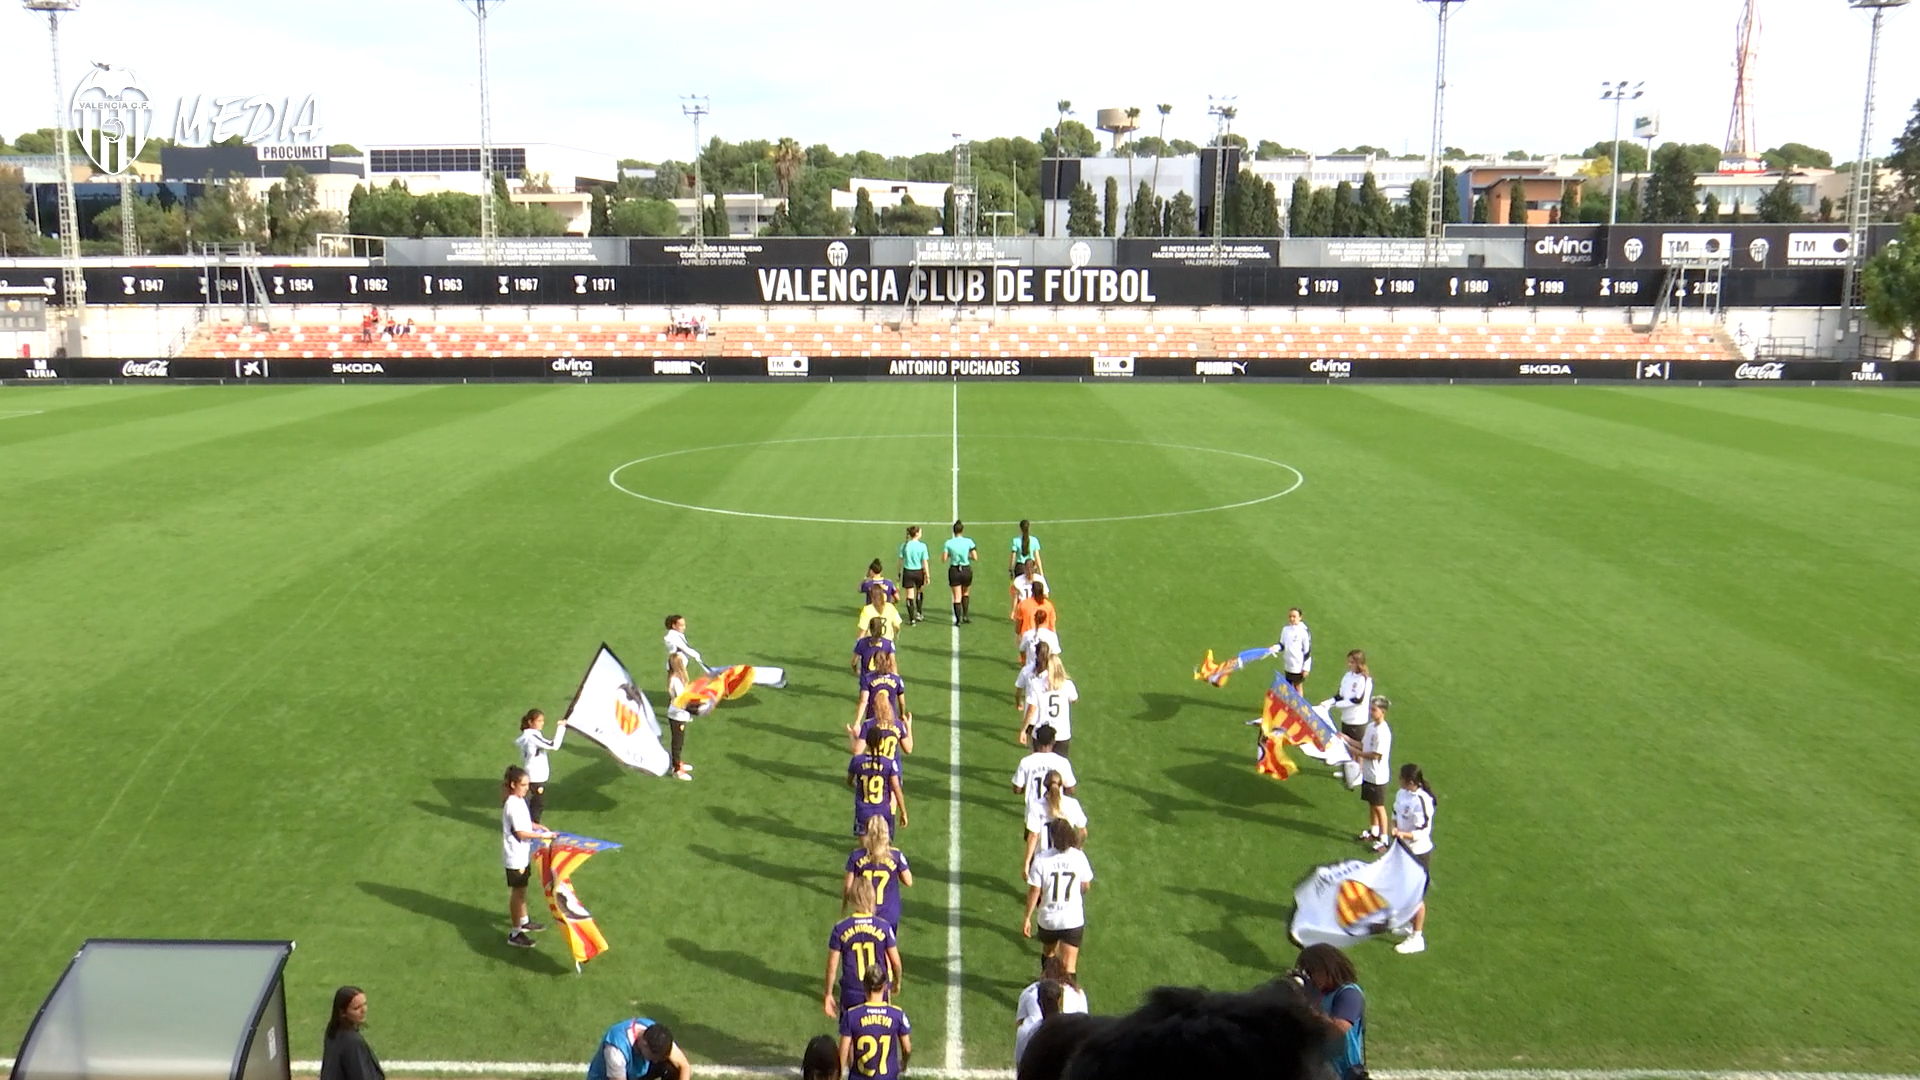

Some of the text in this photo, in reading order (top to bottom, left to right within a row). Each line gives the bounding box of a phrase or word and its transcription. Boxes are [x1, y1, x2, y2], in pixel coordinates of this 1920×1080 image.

[263, 146, 323, 159] PROCUMET
[1535, 235, 1593, 254] divina
[1668, 241, 1689, 252] TM
[1795, 241, 1816, 251] TM
[1562, 255, 1592, 264] seguros
[140, 279, 164, 292] 1947
[289, 279, 314, 292] 1954
[364, 279, 388, 292] 1962
[438, 279, 463, 292] 1963
[514, 279, 539, 292] 1967
[592, 279, 615, 292] 1971
[758, 262, 1156, 302] VALENCIA CLUB DE FÚTBOL
[1313, 280, 1339, 294] 1979
[1389, 280, 1414, 294] 1980
[1464, 280, 1489, 294] 1980
[1539, 280, 1564, 294] 1999
[1614, 280, 1639, 294] 1999
[332, 363, 384, 373] SKODA
[552, 358, 593, 372] divina
[654, 361, 691, 374] PUMA
[889, 360, 1020, 375] ANTONIO PUCHADES
[1196, 361, 1232, 374] PUMA
[1309, 360, 1351, 372] divina
[1520, 365, 1571, 374] SKODA
[25, 370, 57, 378] TURIA
[1851, 372, 1883, 381] TURIA
[1049, 695, 1060, 718] 5
[860, 775, 884, 804] 19
[1050, 872, 1076, 902] 17
[852, 942, 875, 981] 11
[857, 1035, 891, 1077] 21
